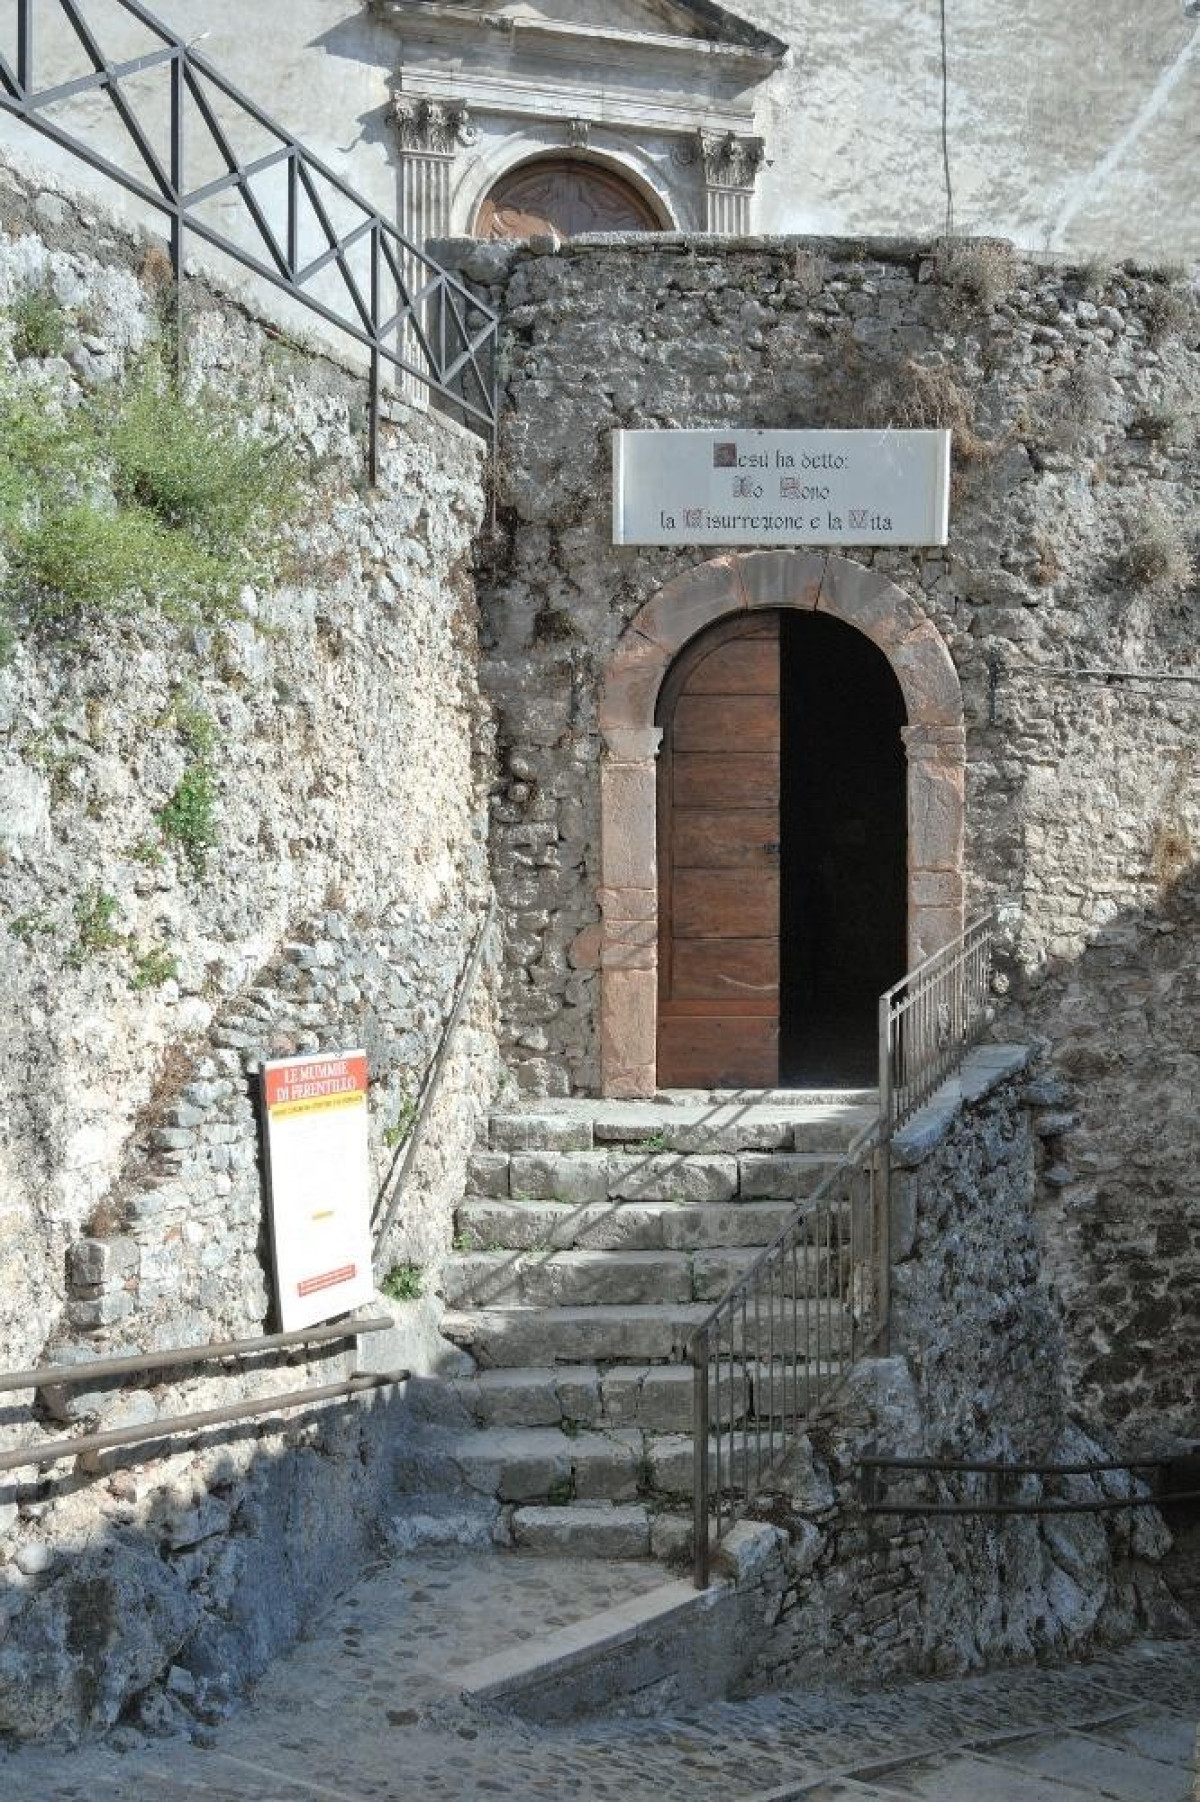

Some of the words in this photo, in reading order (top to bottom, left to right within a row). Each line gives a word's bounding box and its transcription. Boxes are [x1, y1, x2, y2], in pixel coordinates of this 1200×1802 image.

[713, 443, 768, 468] esù
[776, 449, 795, 468] ha
[801, 450, 849, 469] detto:
[660, 511, 676, 530] la
[683, 507, 803, 531] Risurrezione
[810, 515, 821, 529] e
[828, 511, 842, 530] la
[848, 509, 893, 531] Vita
[284, 1066, 298, 1084] LE
[300, 1060, 347, 1082] MUMMIE
[276, 1086, 289, 1102] DI
